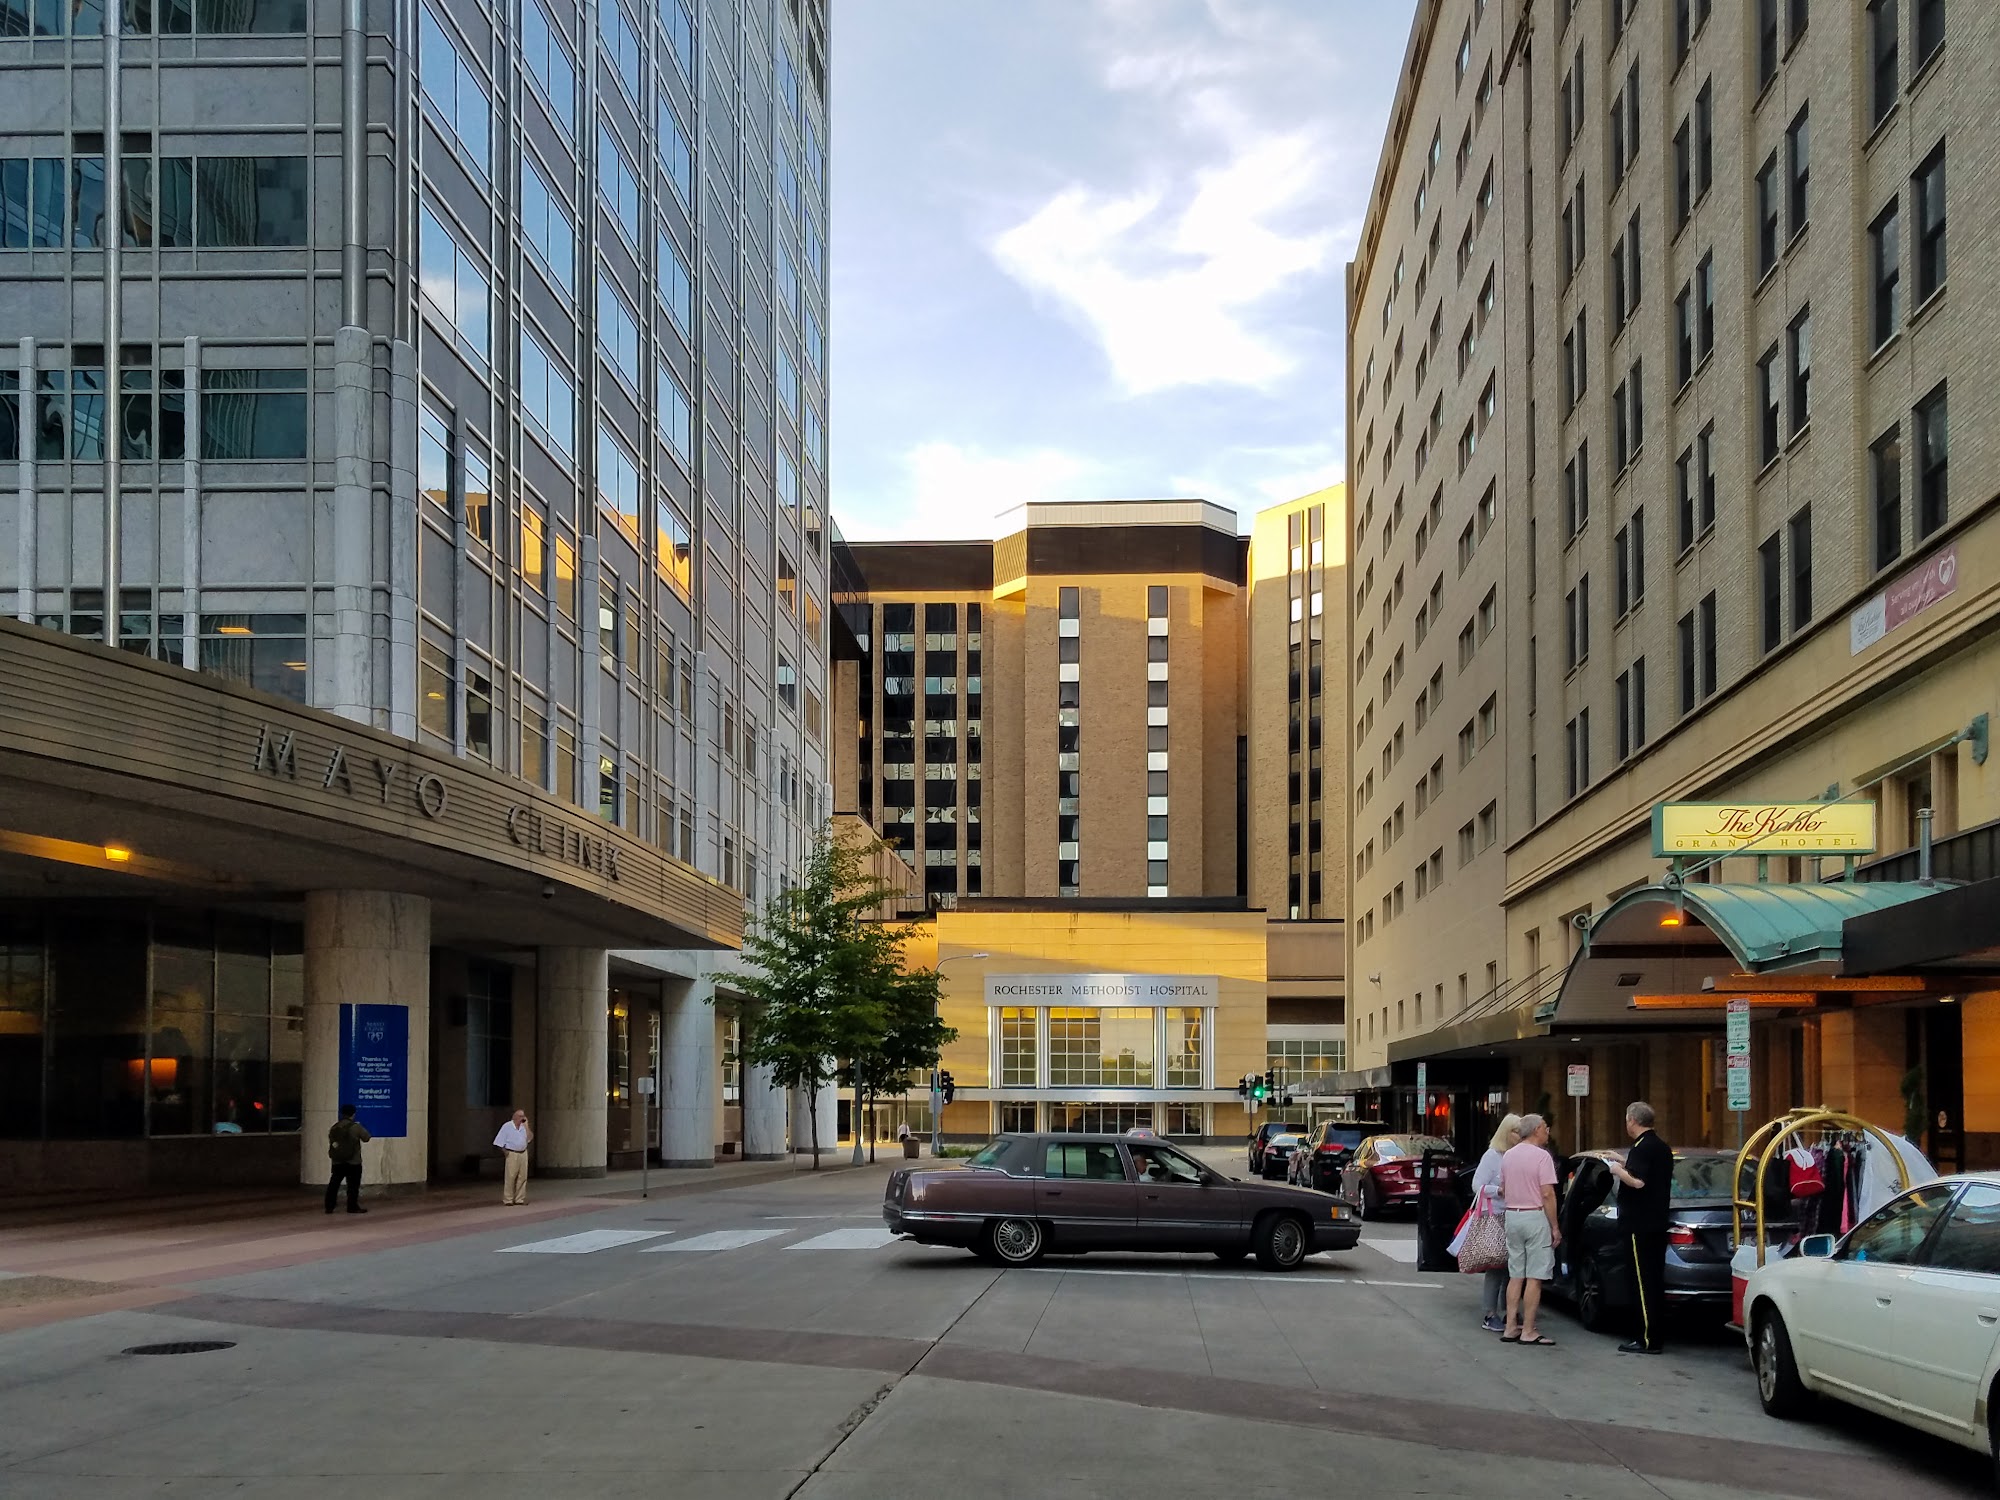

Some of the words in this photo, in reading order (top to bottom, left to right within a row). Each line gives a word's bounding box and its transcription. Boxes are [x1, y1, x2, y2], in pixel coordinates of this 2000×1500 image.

[254, 724, 448, 818] MAYO
[506, 805, 621, 881] CLINIC
[1705, 808, 1754, 834] The
[1731, 807, 1827, 839] Kahler
[1780, 838, 1857, 847] HOTEL
[994, 985, 1063, 995] ROCHESTER
[1071, 985, 1141, 995] METHODIST
[1150, 985, 1208, 995] HOSPITAL
